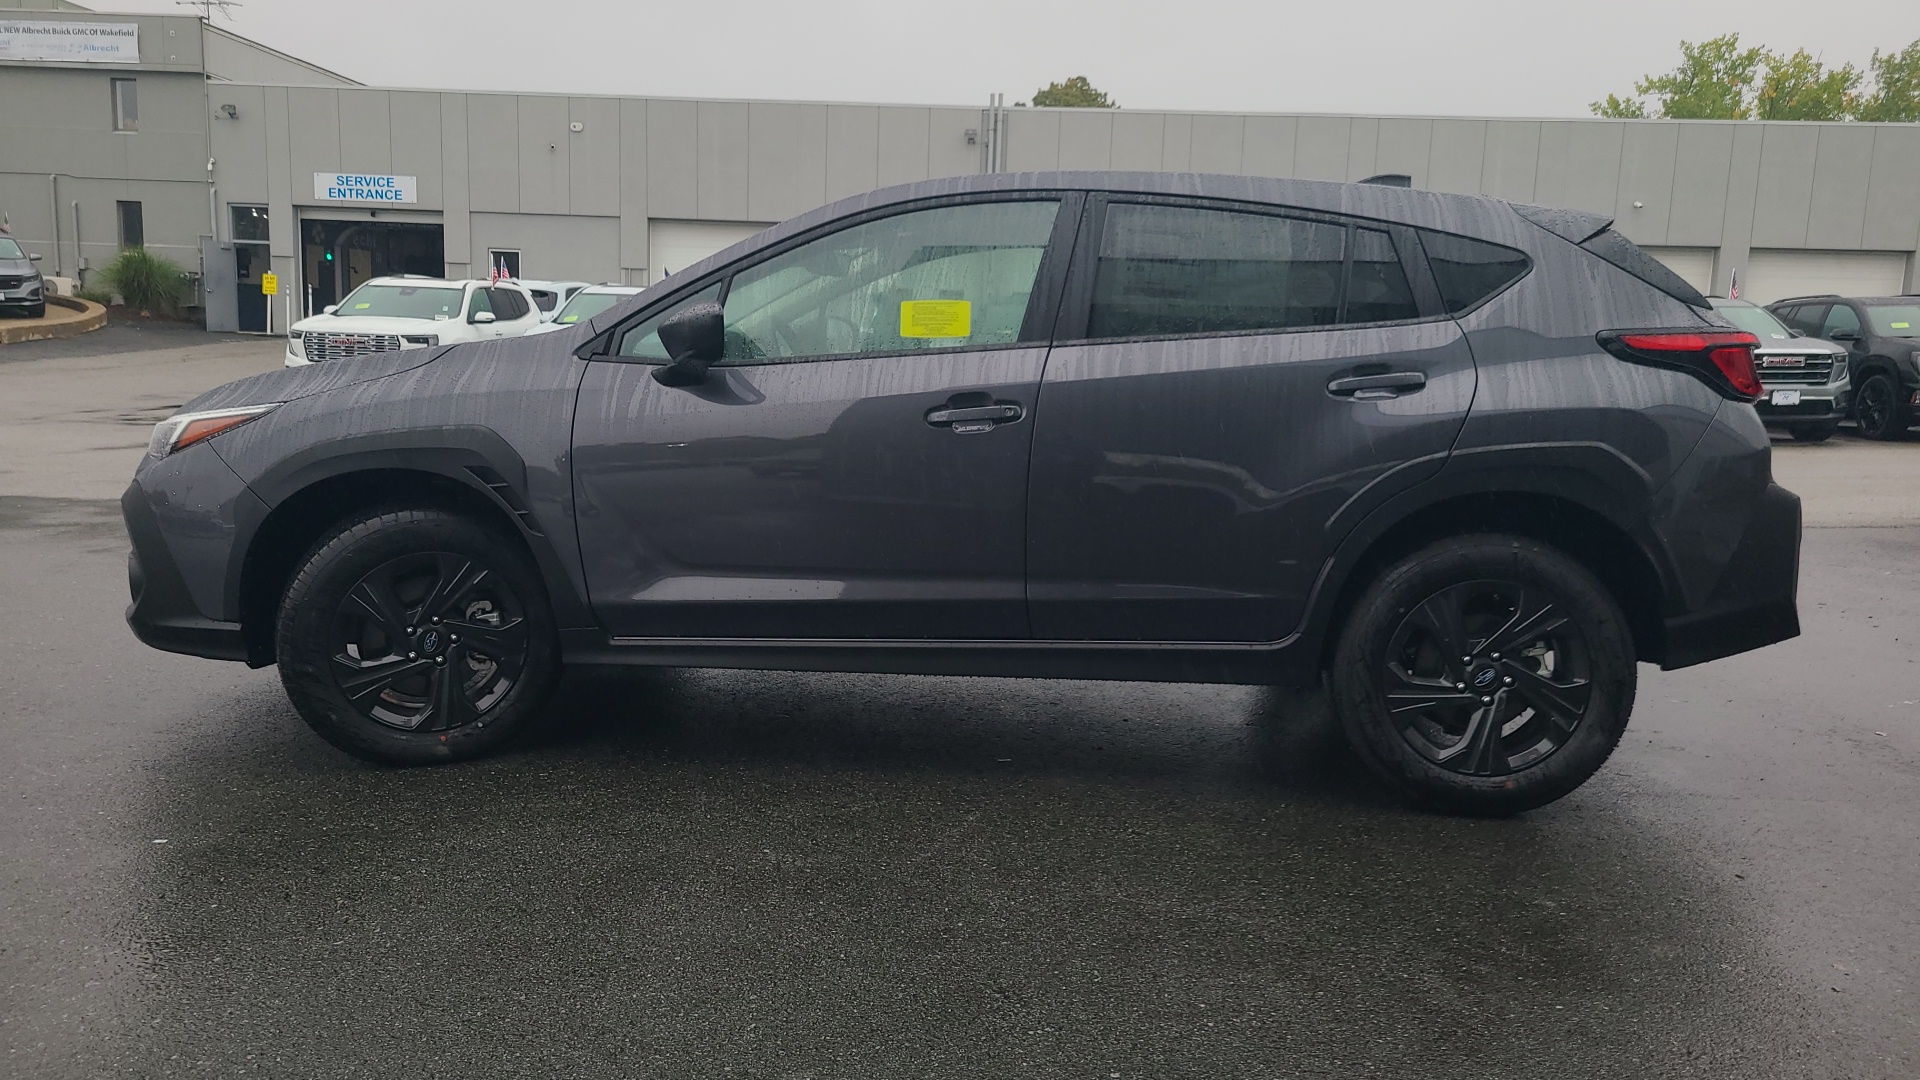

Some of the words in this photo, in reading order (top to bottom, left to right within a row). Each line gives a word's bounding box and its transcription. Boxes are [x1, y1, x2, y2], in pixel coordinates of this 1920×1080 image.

[4, 26, 20, 34] NEW
[21, 26, 51, 35] Albrecht
[51, 27, 71, 35] Buick
[72, 28, 89, 36] GMC
[89, 28, 98, 36] Of
[99, 28, 134, 37] Wakefield
[83, 43, 120, 52] Albrecht
[336, 175, 395, 188] SERVICE
[328, 187, 403, 201] ENTRANCE
[1767, 357, 1805, 366] GMC
